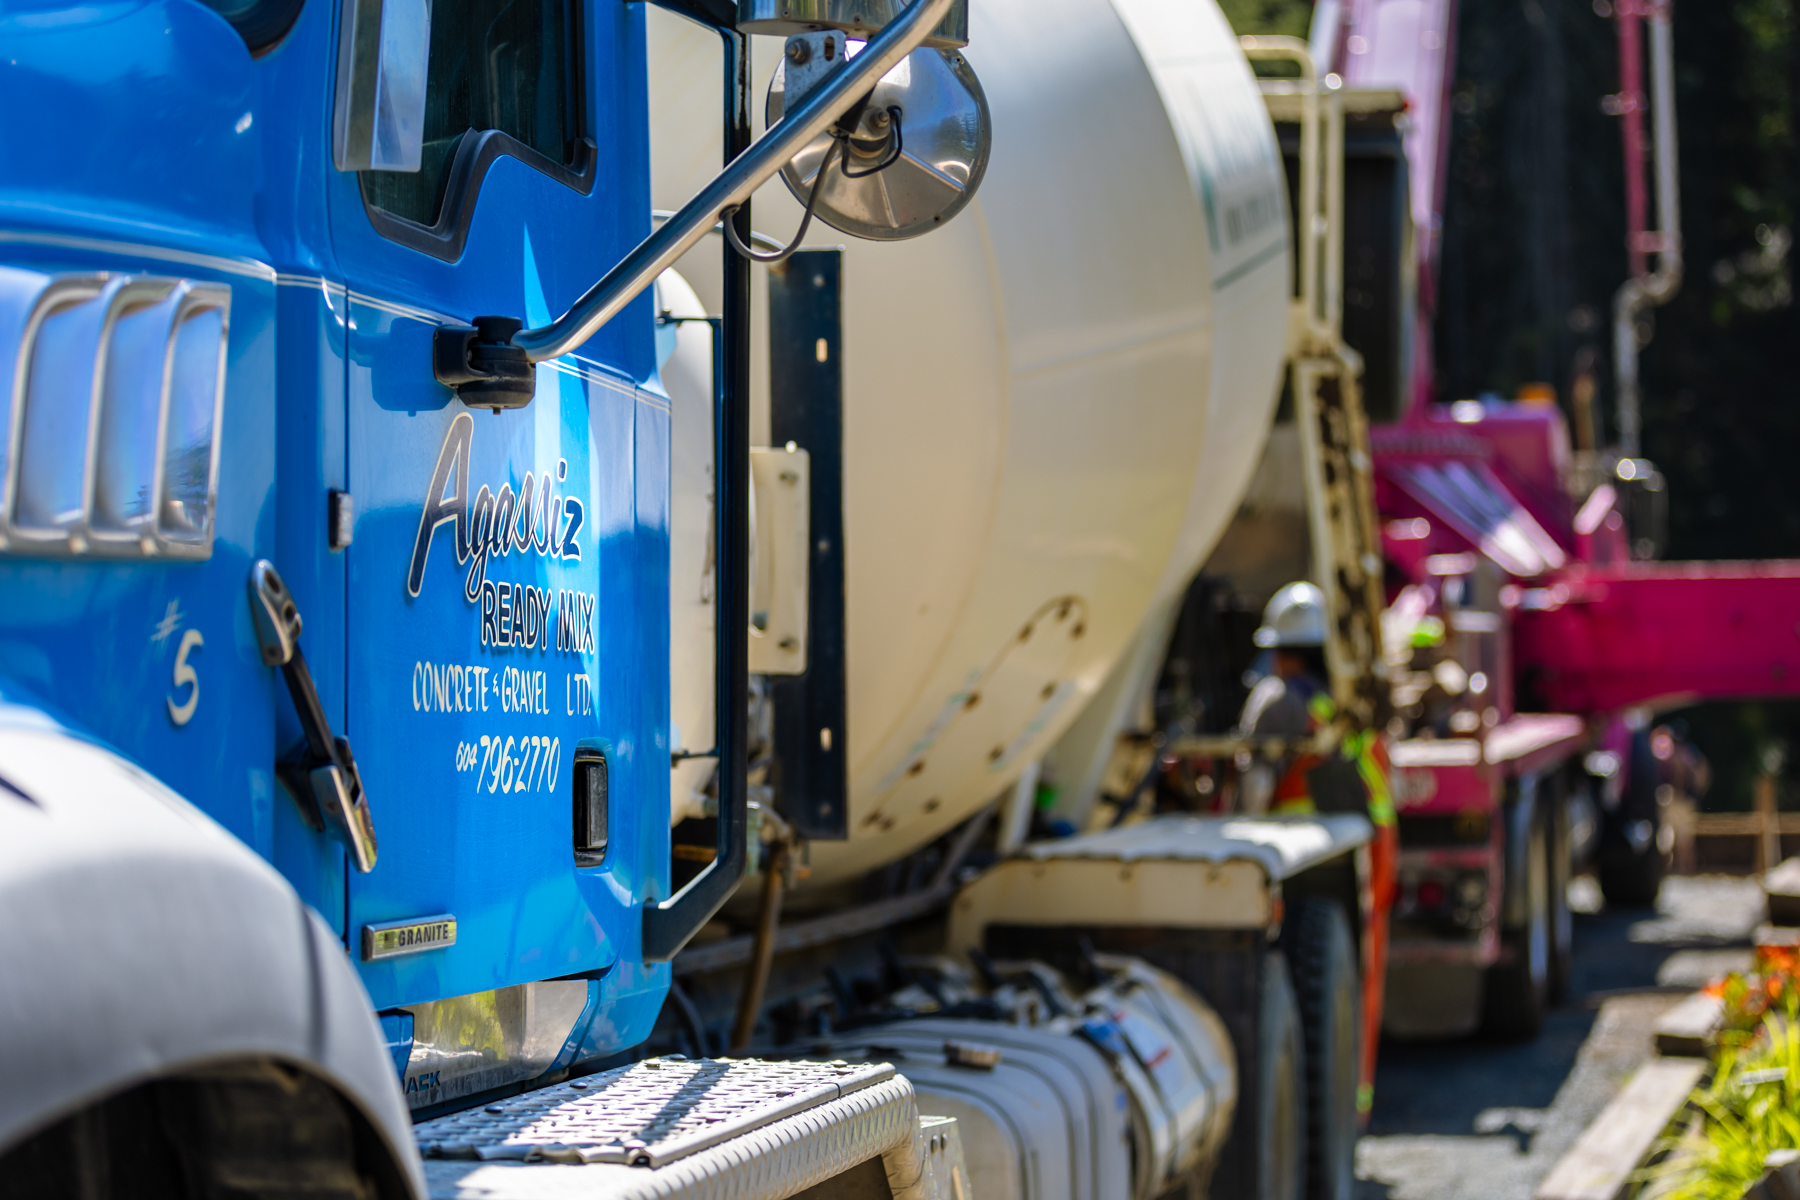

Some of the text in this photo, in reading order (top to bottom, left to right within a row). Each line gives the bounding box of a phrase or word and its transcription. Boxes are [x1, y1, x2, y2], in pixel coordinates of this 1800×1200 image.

[408, 412, 584, 603] Agassiz
[482, 580, 596, 655] READY MIX
[412, 660, 490, 713] CONCRETE
[501, 665, 550, 715] GRAVEL
[455, 740, 478, 772] 604
[398, 923, 449, 947] GRANITE
[401, 1070, 441, 1095] ACK
